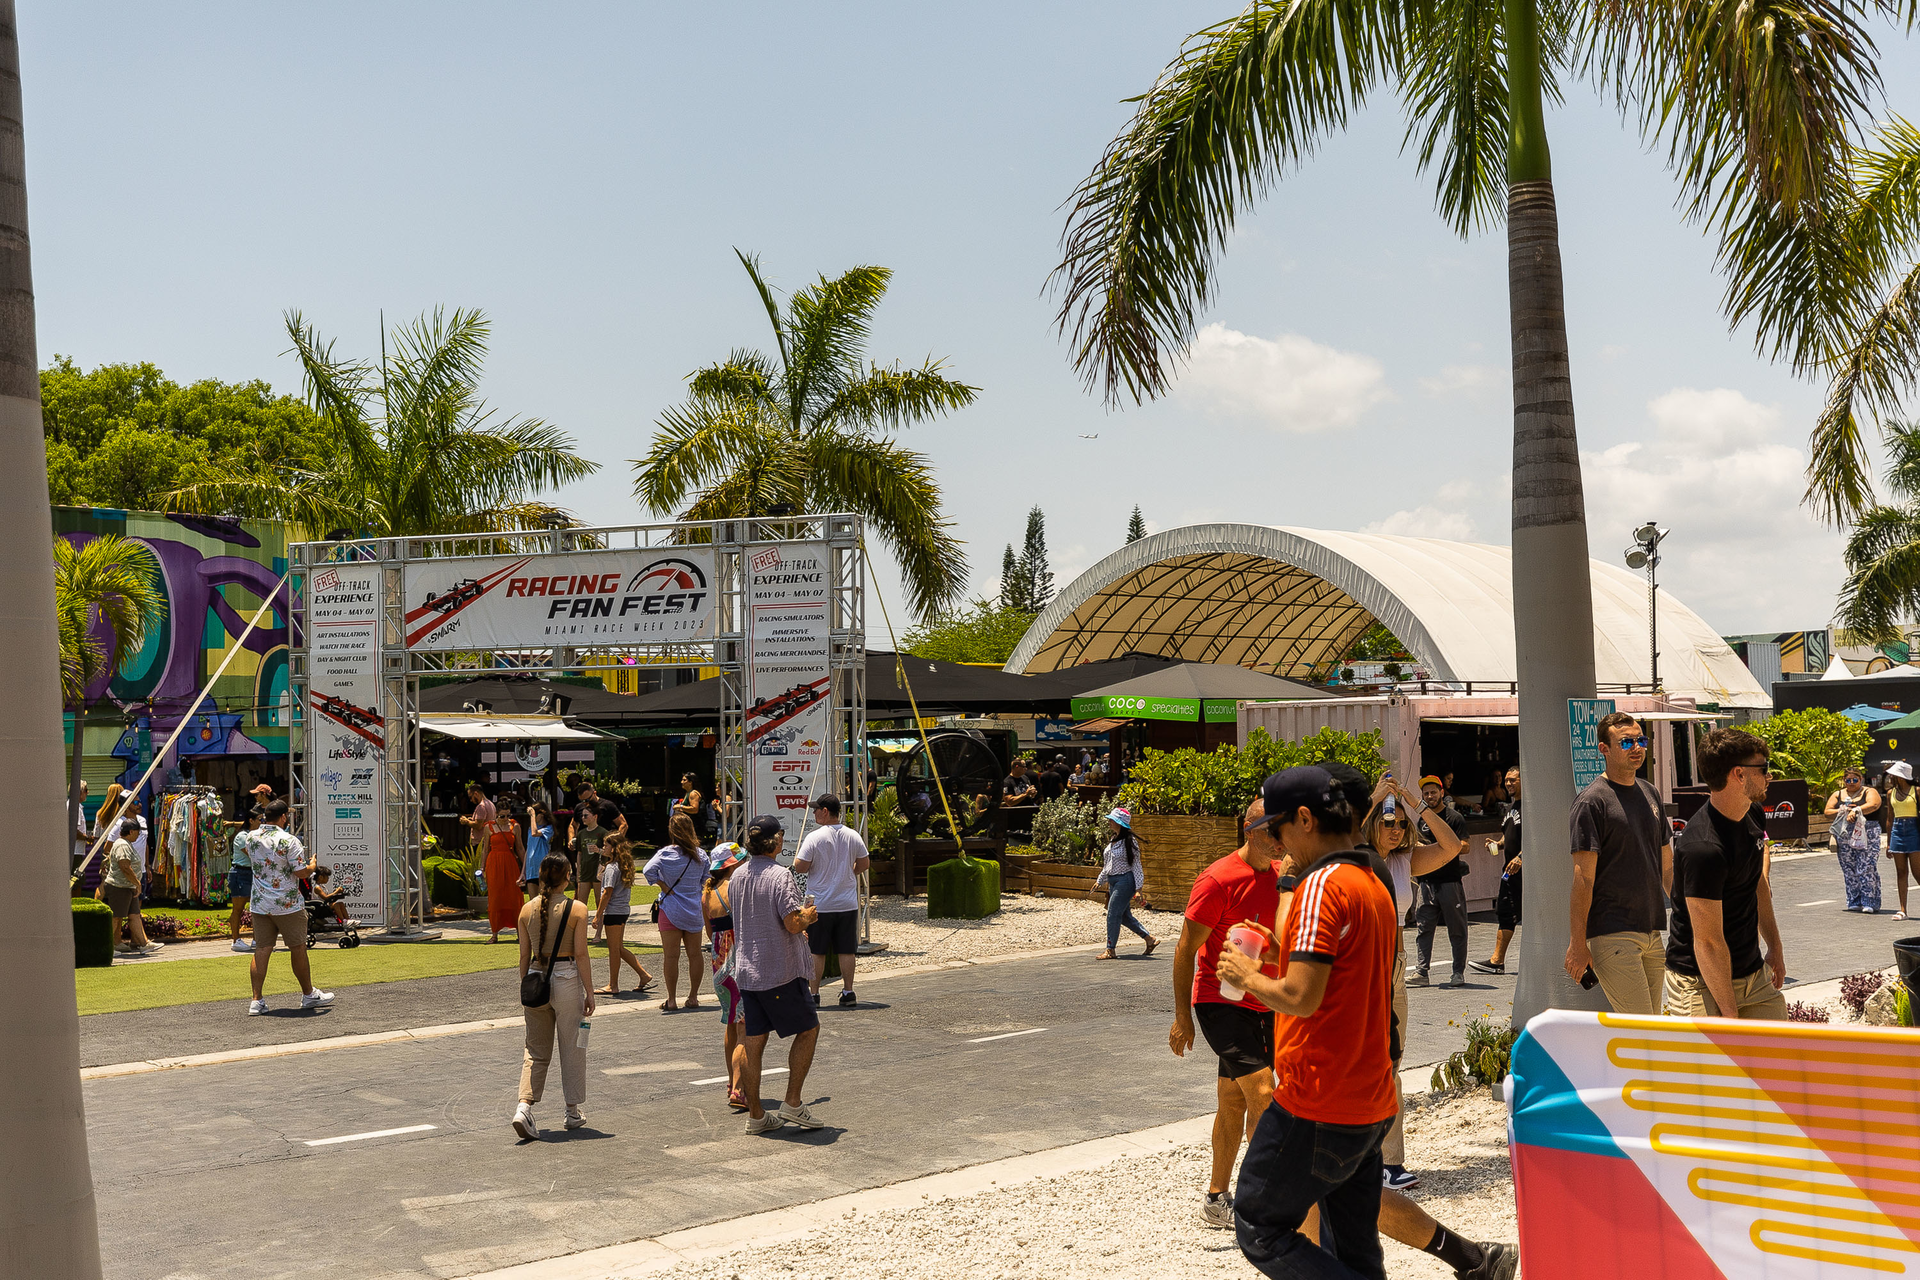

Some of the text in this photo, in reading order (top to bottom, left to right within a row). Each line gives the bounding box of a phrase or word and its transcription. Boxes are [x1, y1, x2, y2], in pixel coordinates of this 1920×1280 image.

[754, 550, 777, 570] FREE
[774, 559, 818, 571] OFF-TRACK
[316, 572, 337, 590] FREE
[754, 572, 823, 585] EXPERIENCE
[334, 580, 370, 591] OFF-TRACK
[506, 574, 622, 598] RACING
[314, 593, 374, 604] EXPERIENCE
[548, 592, 707, 619] FAN FEST
[545, 620, 705, 635] MIAMI RACE WEEK 2023
[1108, 698, 1146, 710] COCO
[1573, 701, 1611, 723] TOW-AWAY
[1573, 724, 1580, 735] 24
[1572, 737, 1582, 747] HRS
[772, 761, 811, 772] ESPN
